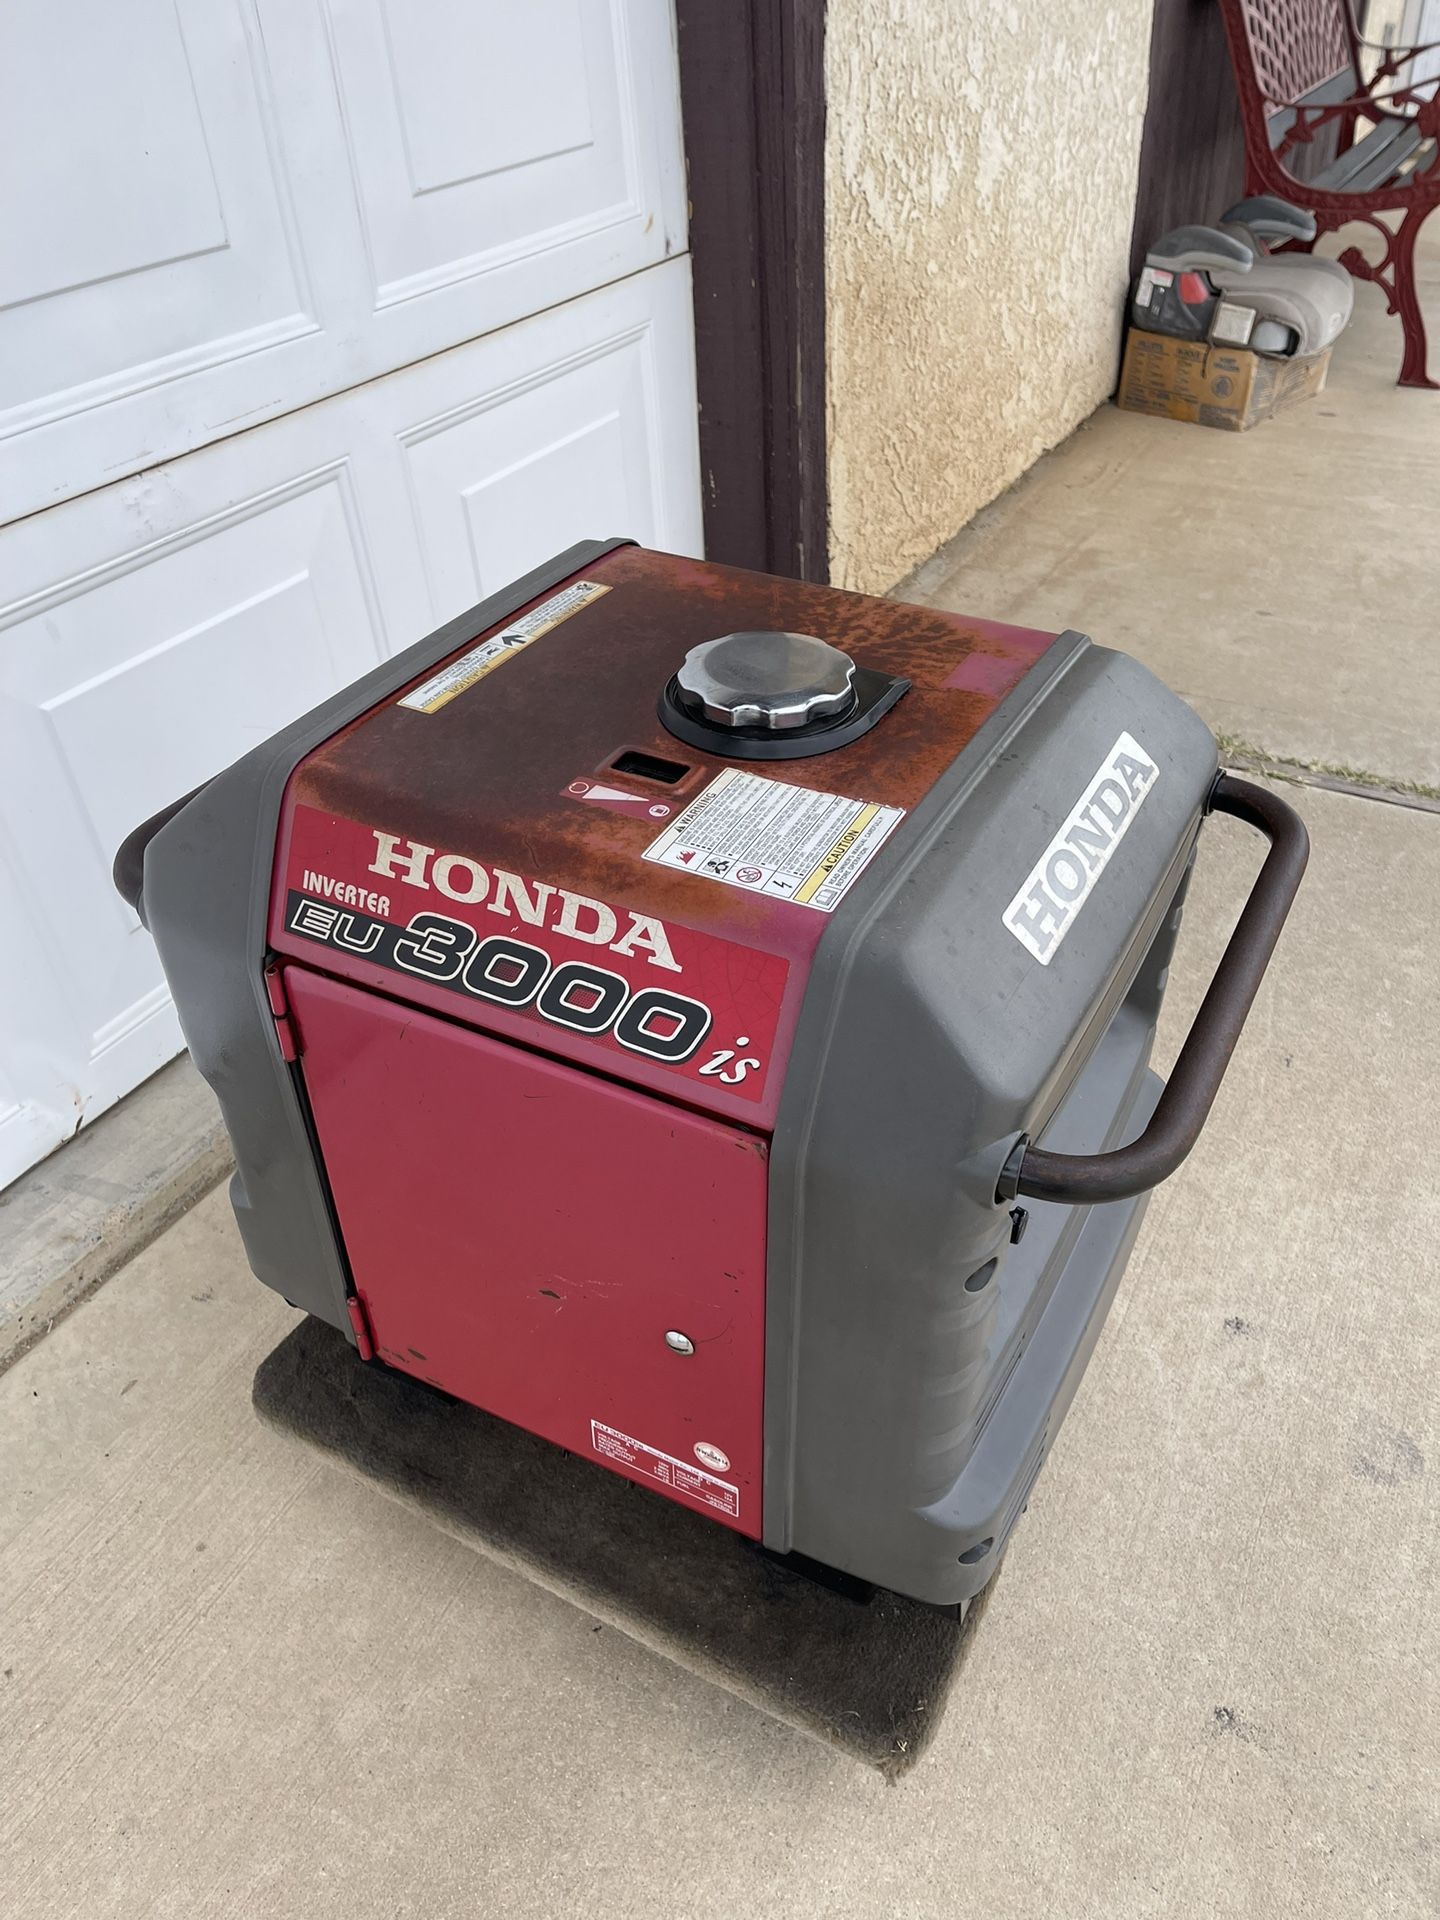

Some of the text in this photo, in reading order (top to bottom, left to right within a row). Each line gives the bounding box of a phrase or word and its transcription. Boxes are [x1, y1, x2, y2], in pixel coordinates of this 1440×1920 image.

[680, 792, 717, 824] WARNING
[827, 830, 859, 863] CAUTION
[1011, 752, 1155, 955] HONDA
[303, 869, 390, 917] INVERTER
[368, 829, 683, 973] HONDA
[291, 899, 761, 1085] EU 3000 is
